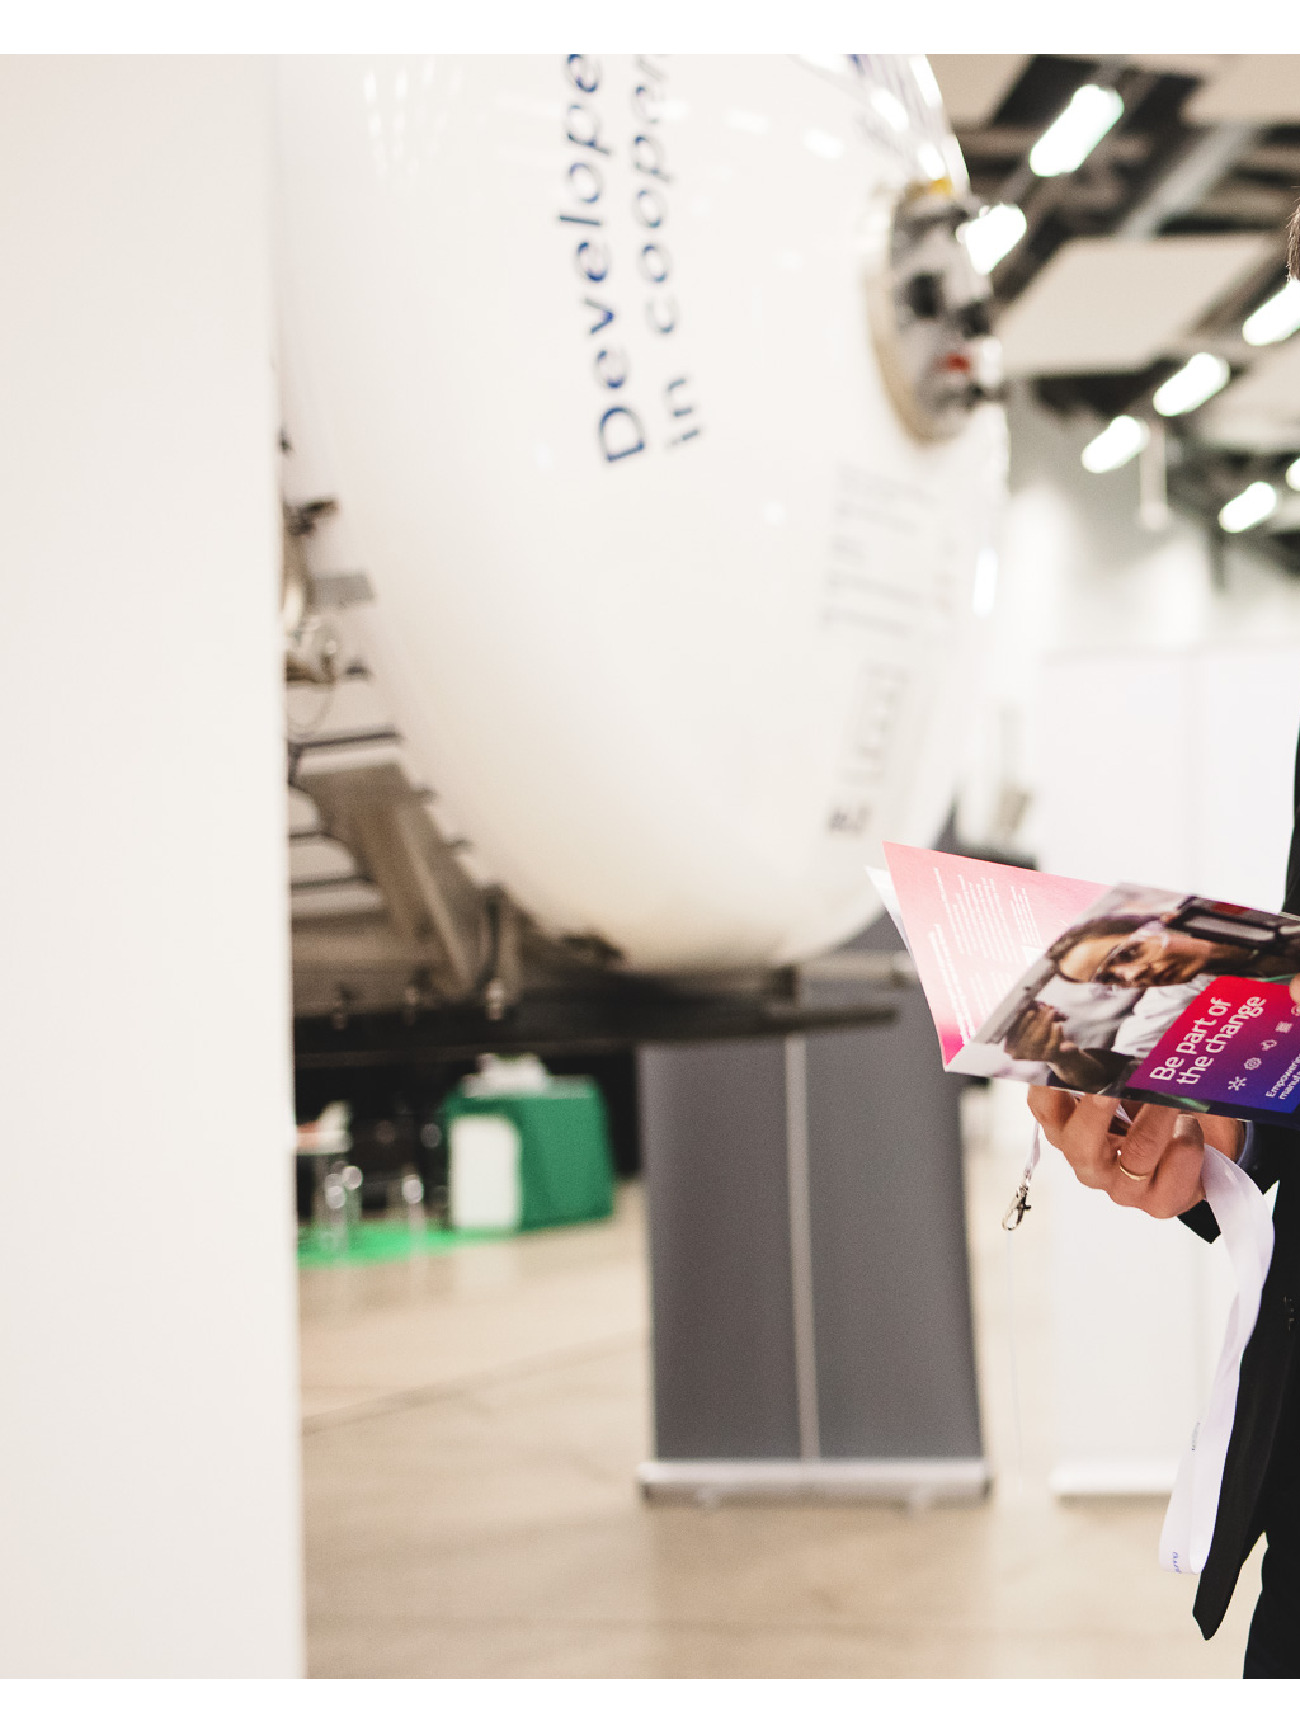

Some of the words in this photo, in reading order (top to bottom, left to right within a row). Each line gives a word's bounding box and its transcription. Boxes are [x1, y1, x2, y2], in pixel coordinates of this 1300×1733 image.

[665, 375, 701, 447] in
[1149, 1056, 1185, 1081] Be
[1175, 1018, 1217, 1055] part
[1208, 996, 1232, 1017] of
[1176, 1056, 1215, 1085] the
[1205, 996, 1267, 1054] change
